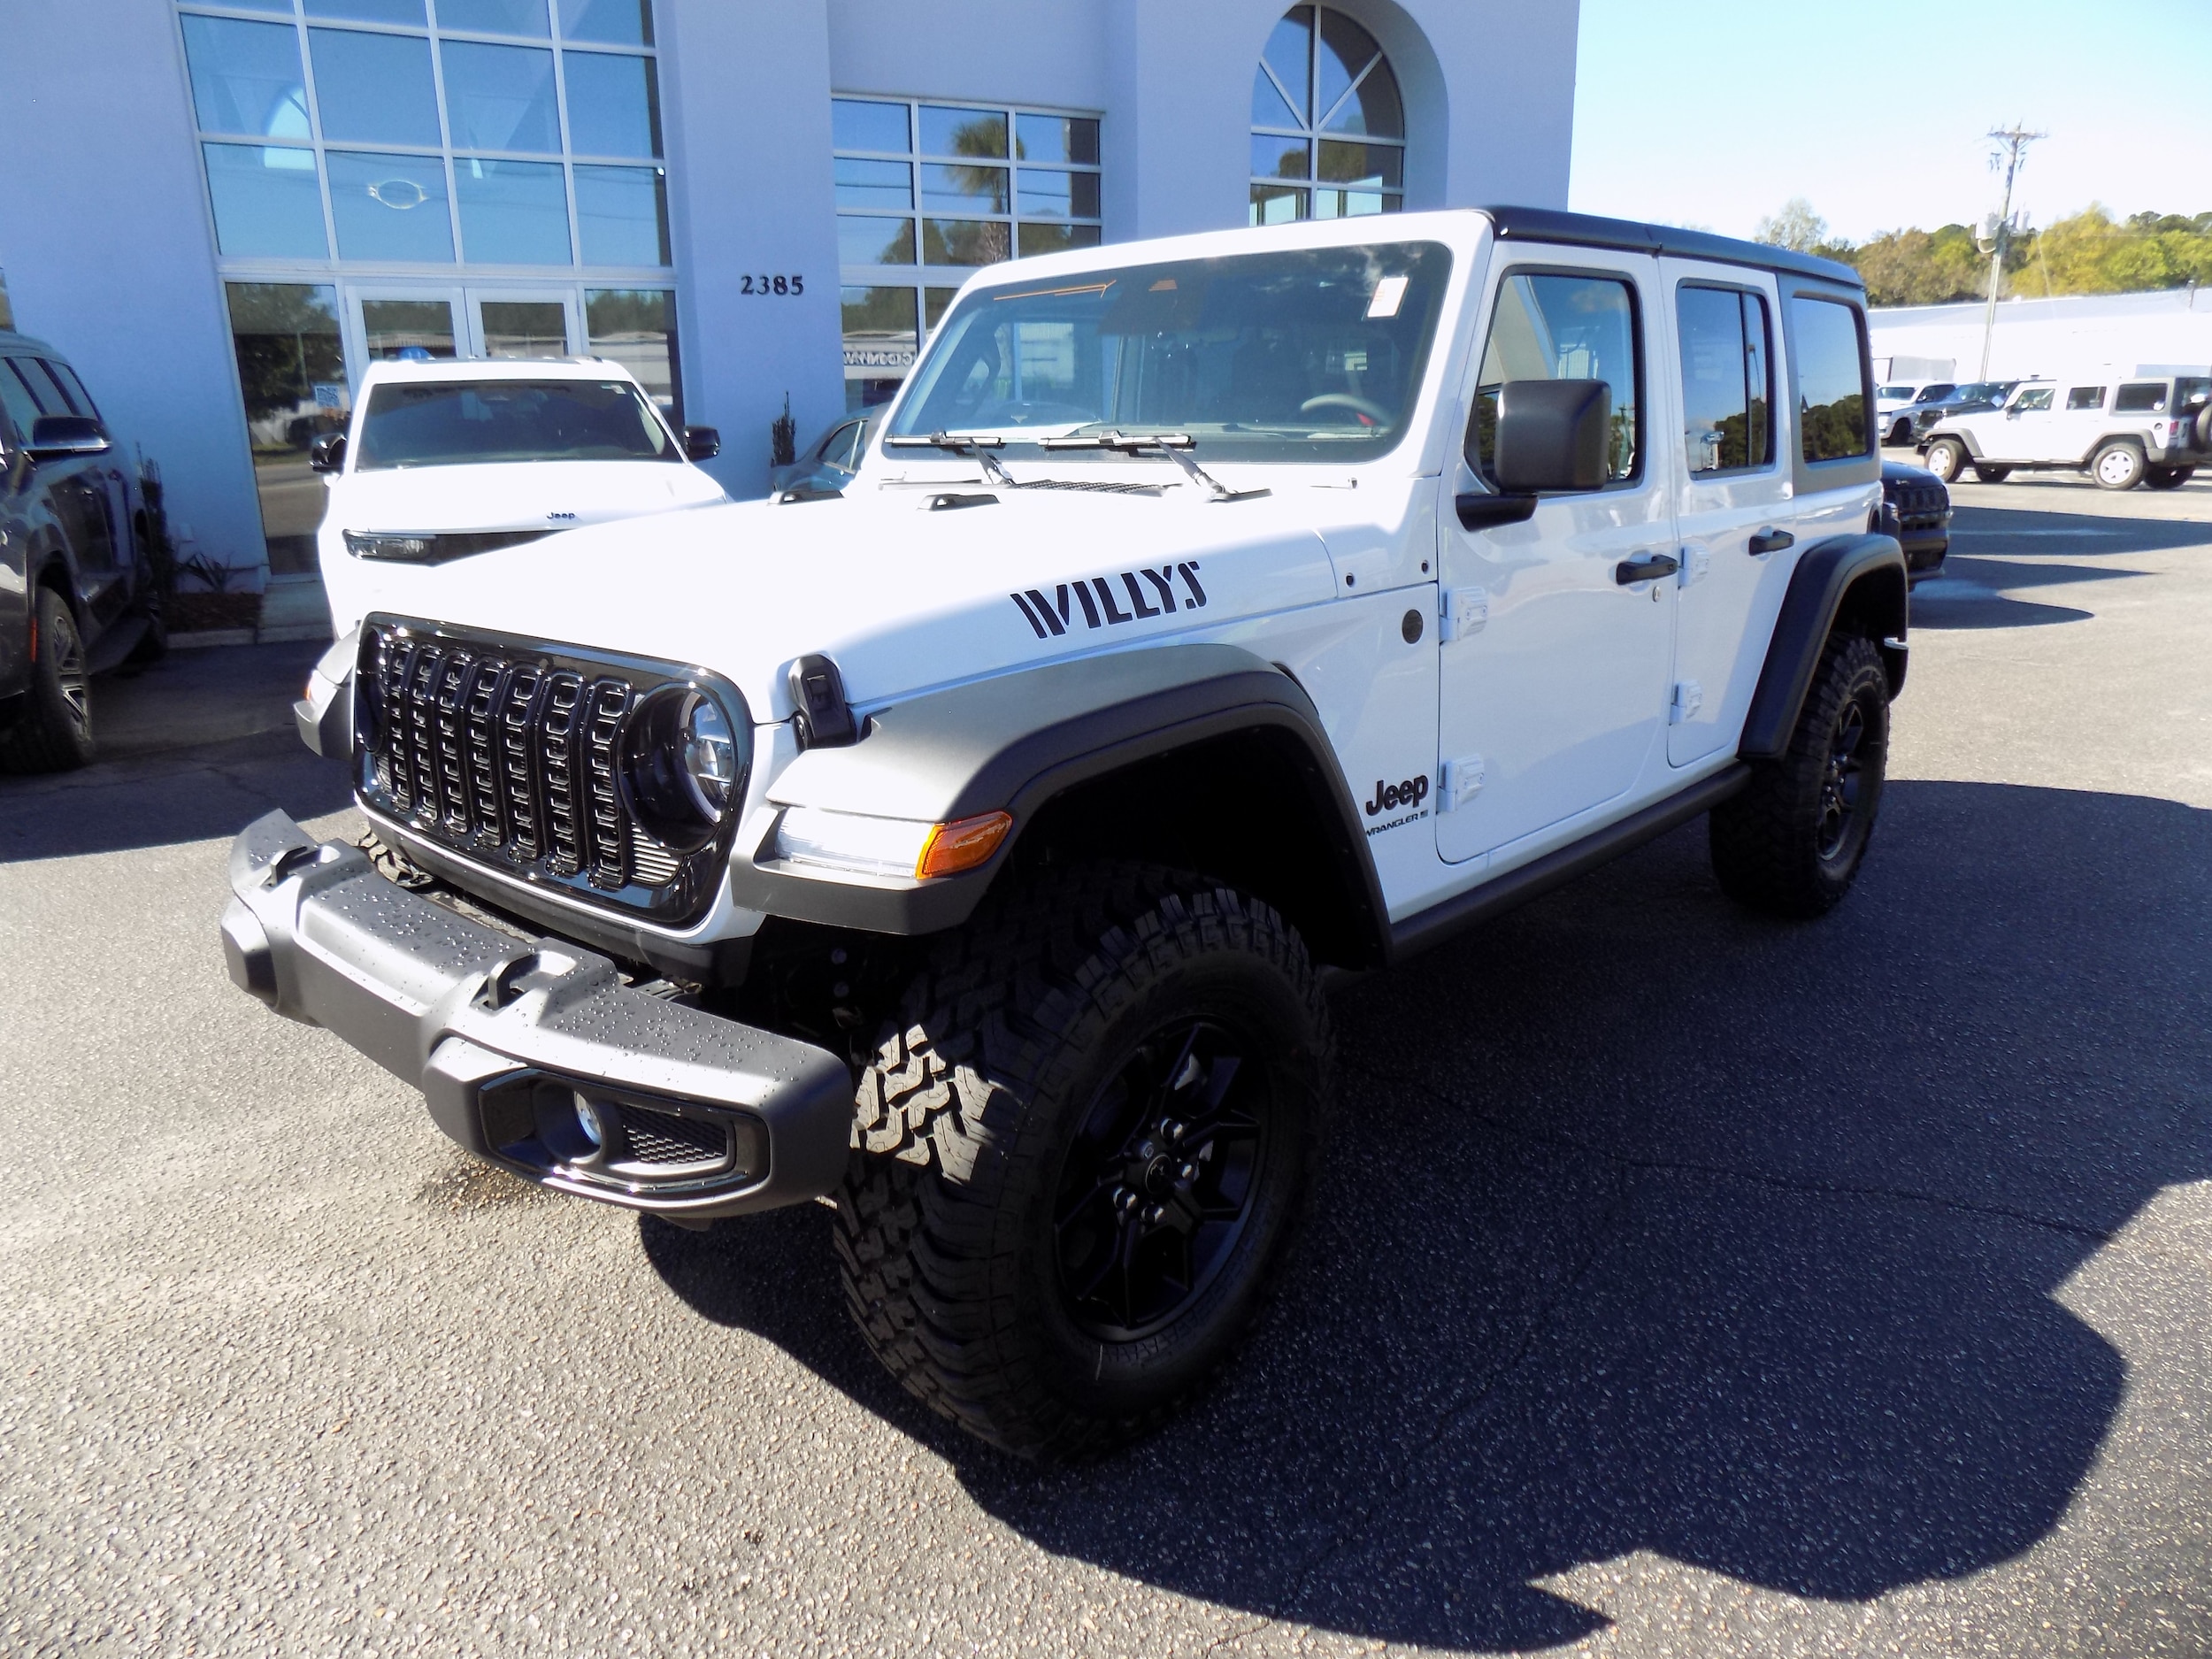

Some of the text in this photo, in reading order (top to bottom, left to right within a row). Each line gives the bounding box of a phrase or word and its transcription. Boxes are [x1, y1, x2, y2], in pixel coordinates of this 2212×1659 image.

[741, 275, 804, 296] 2385
[546, 511, 576, 520] Jeep
[1010, 560, 1207, 639] WILLYS
[1365, 774, 1429, 817] Jeep
